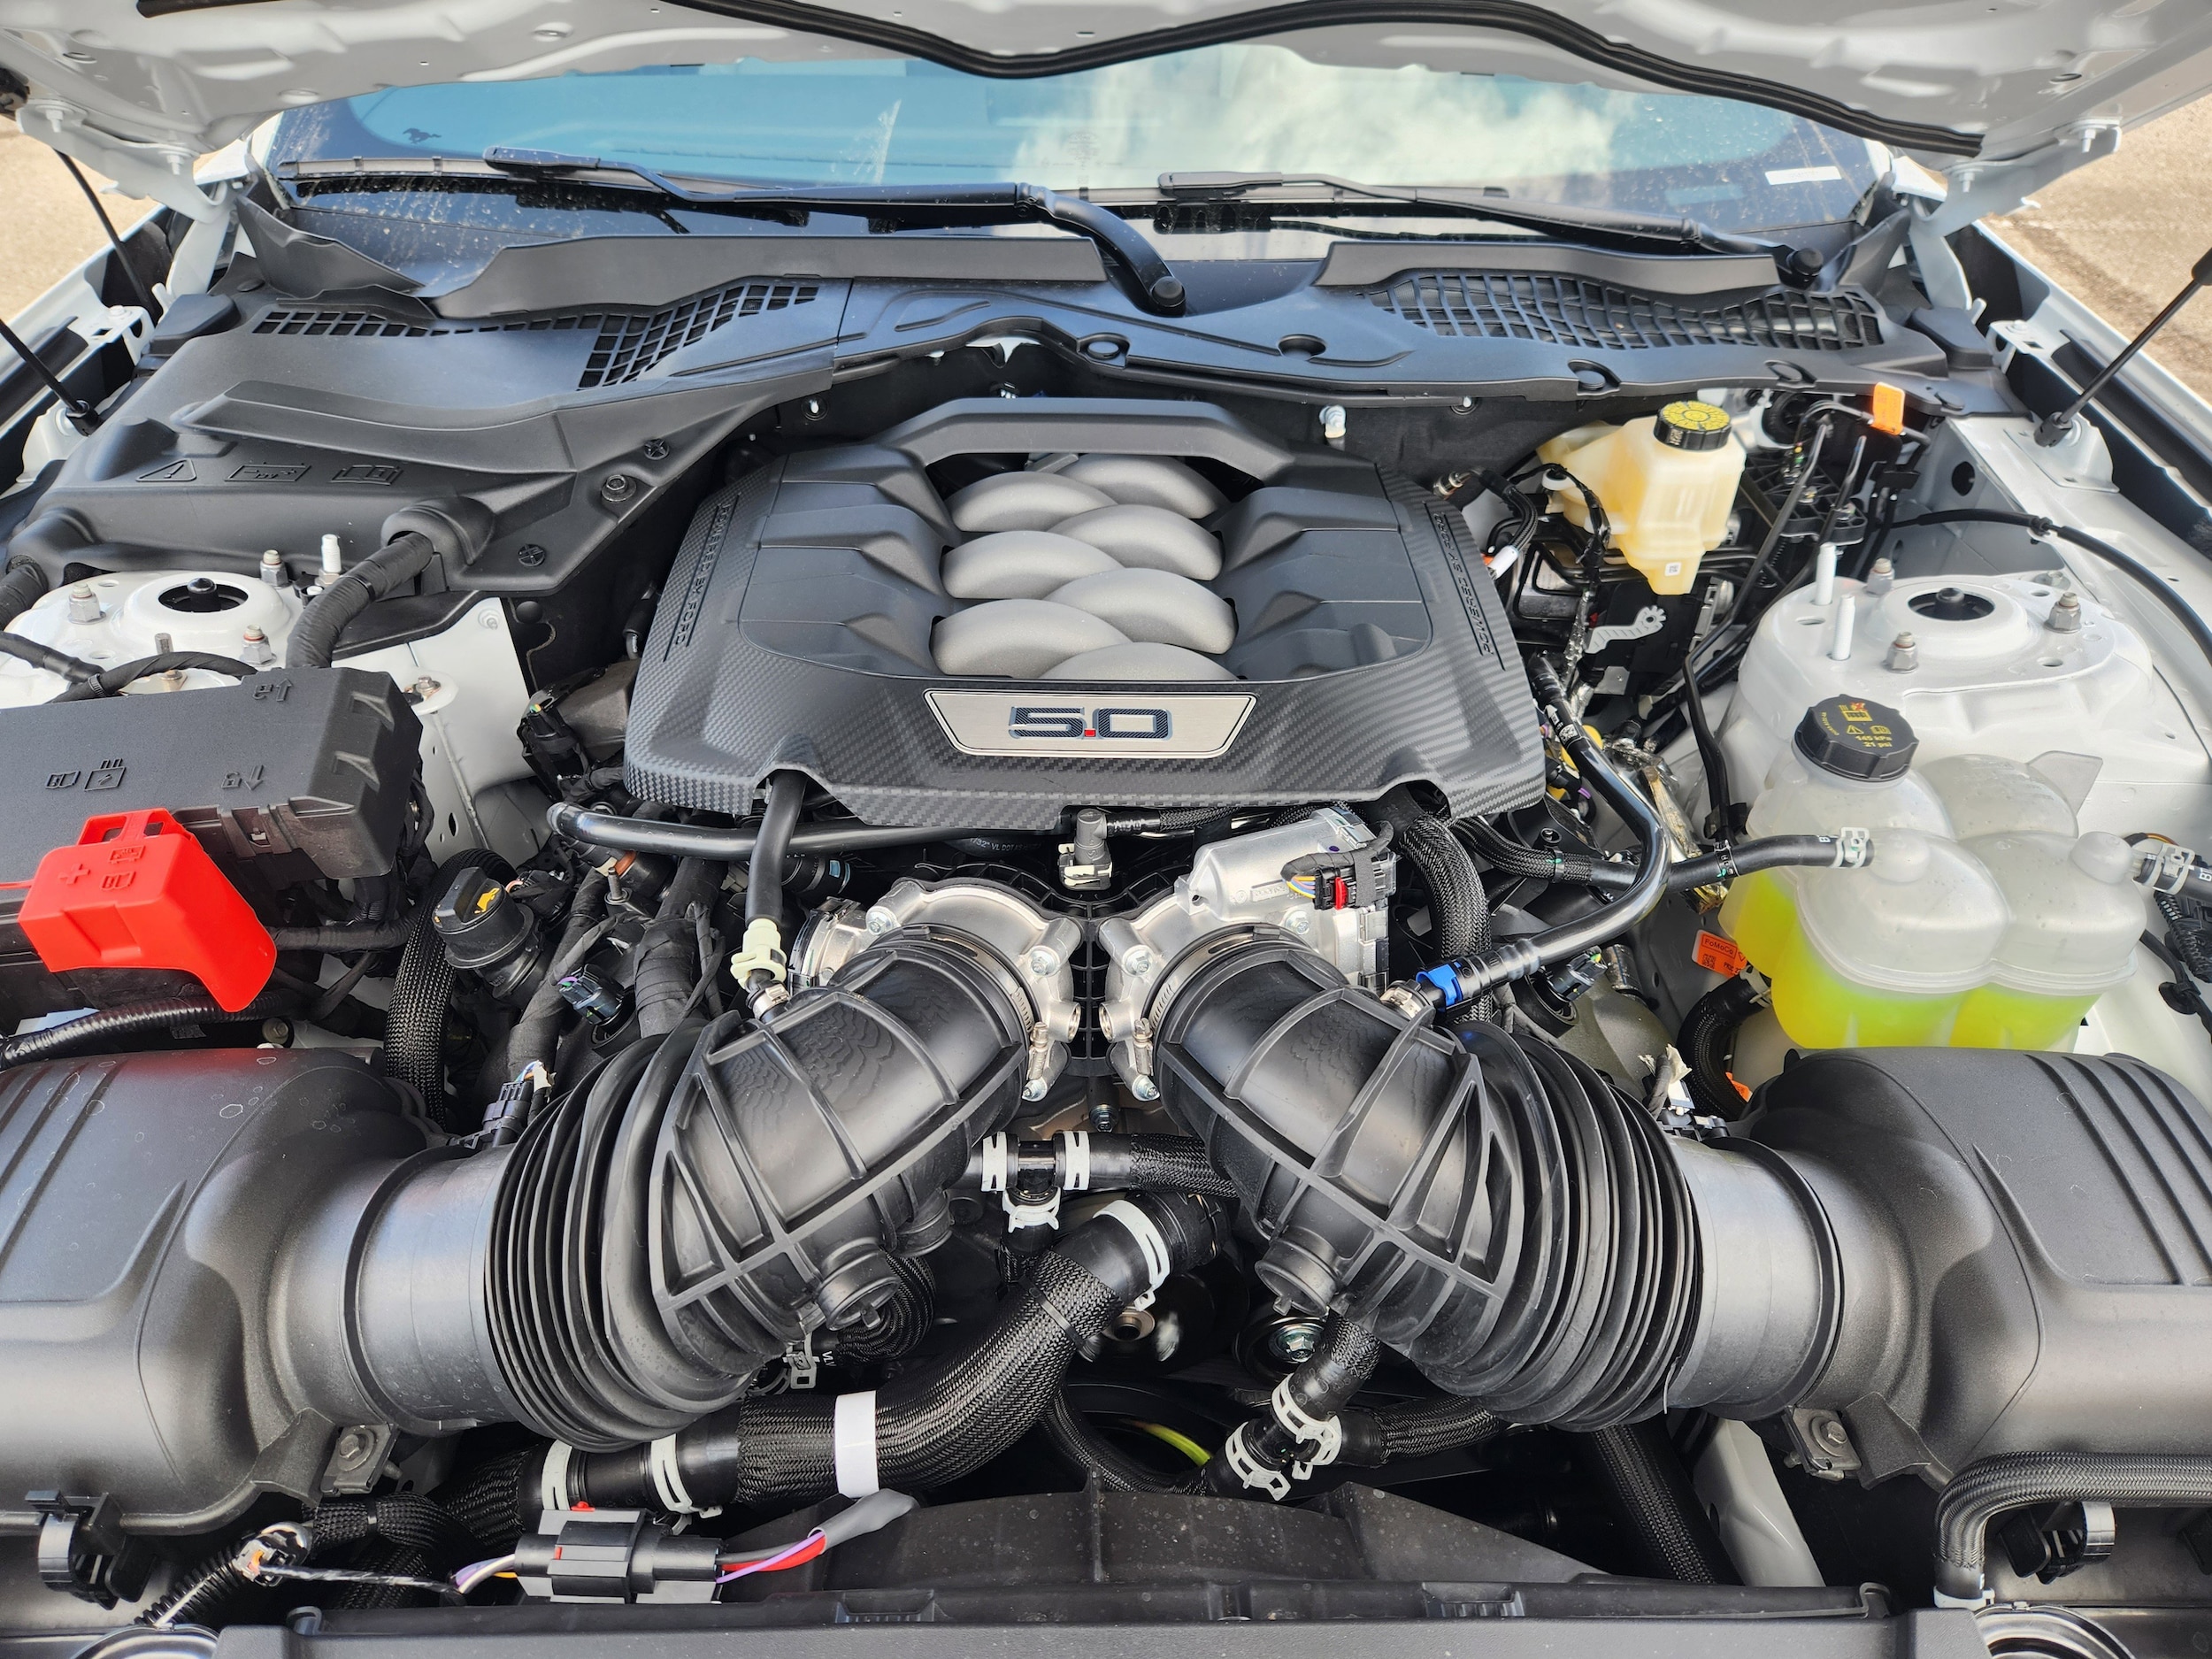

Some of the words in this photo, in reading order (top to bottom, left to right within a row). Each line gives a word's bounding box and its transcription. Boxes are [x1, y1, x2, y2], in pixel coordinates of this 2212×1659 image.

[700, 504, 733, 572] POWERED
[1432, 512, 1455, 550] FORD
[1448, 552, 1463, 573] BY
[692, 575, 708, 595] BY
[675, 600, 697, 646] FORD
[1457, 576, 1494, 655] POWERED
[1008, 706, 1173, 741] 5.0
[1704, 938, 1734, 955] FoMoCo
